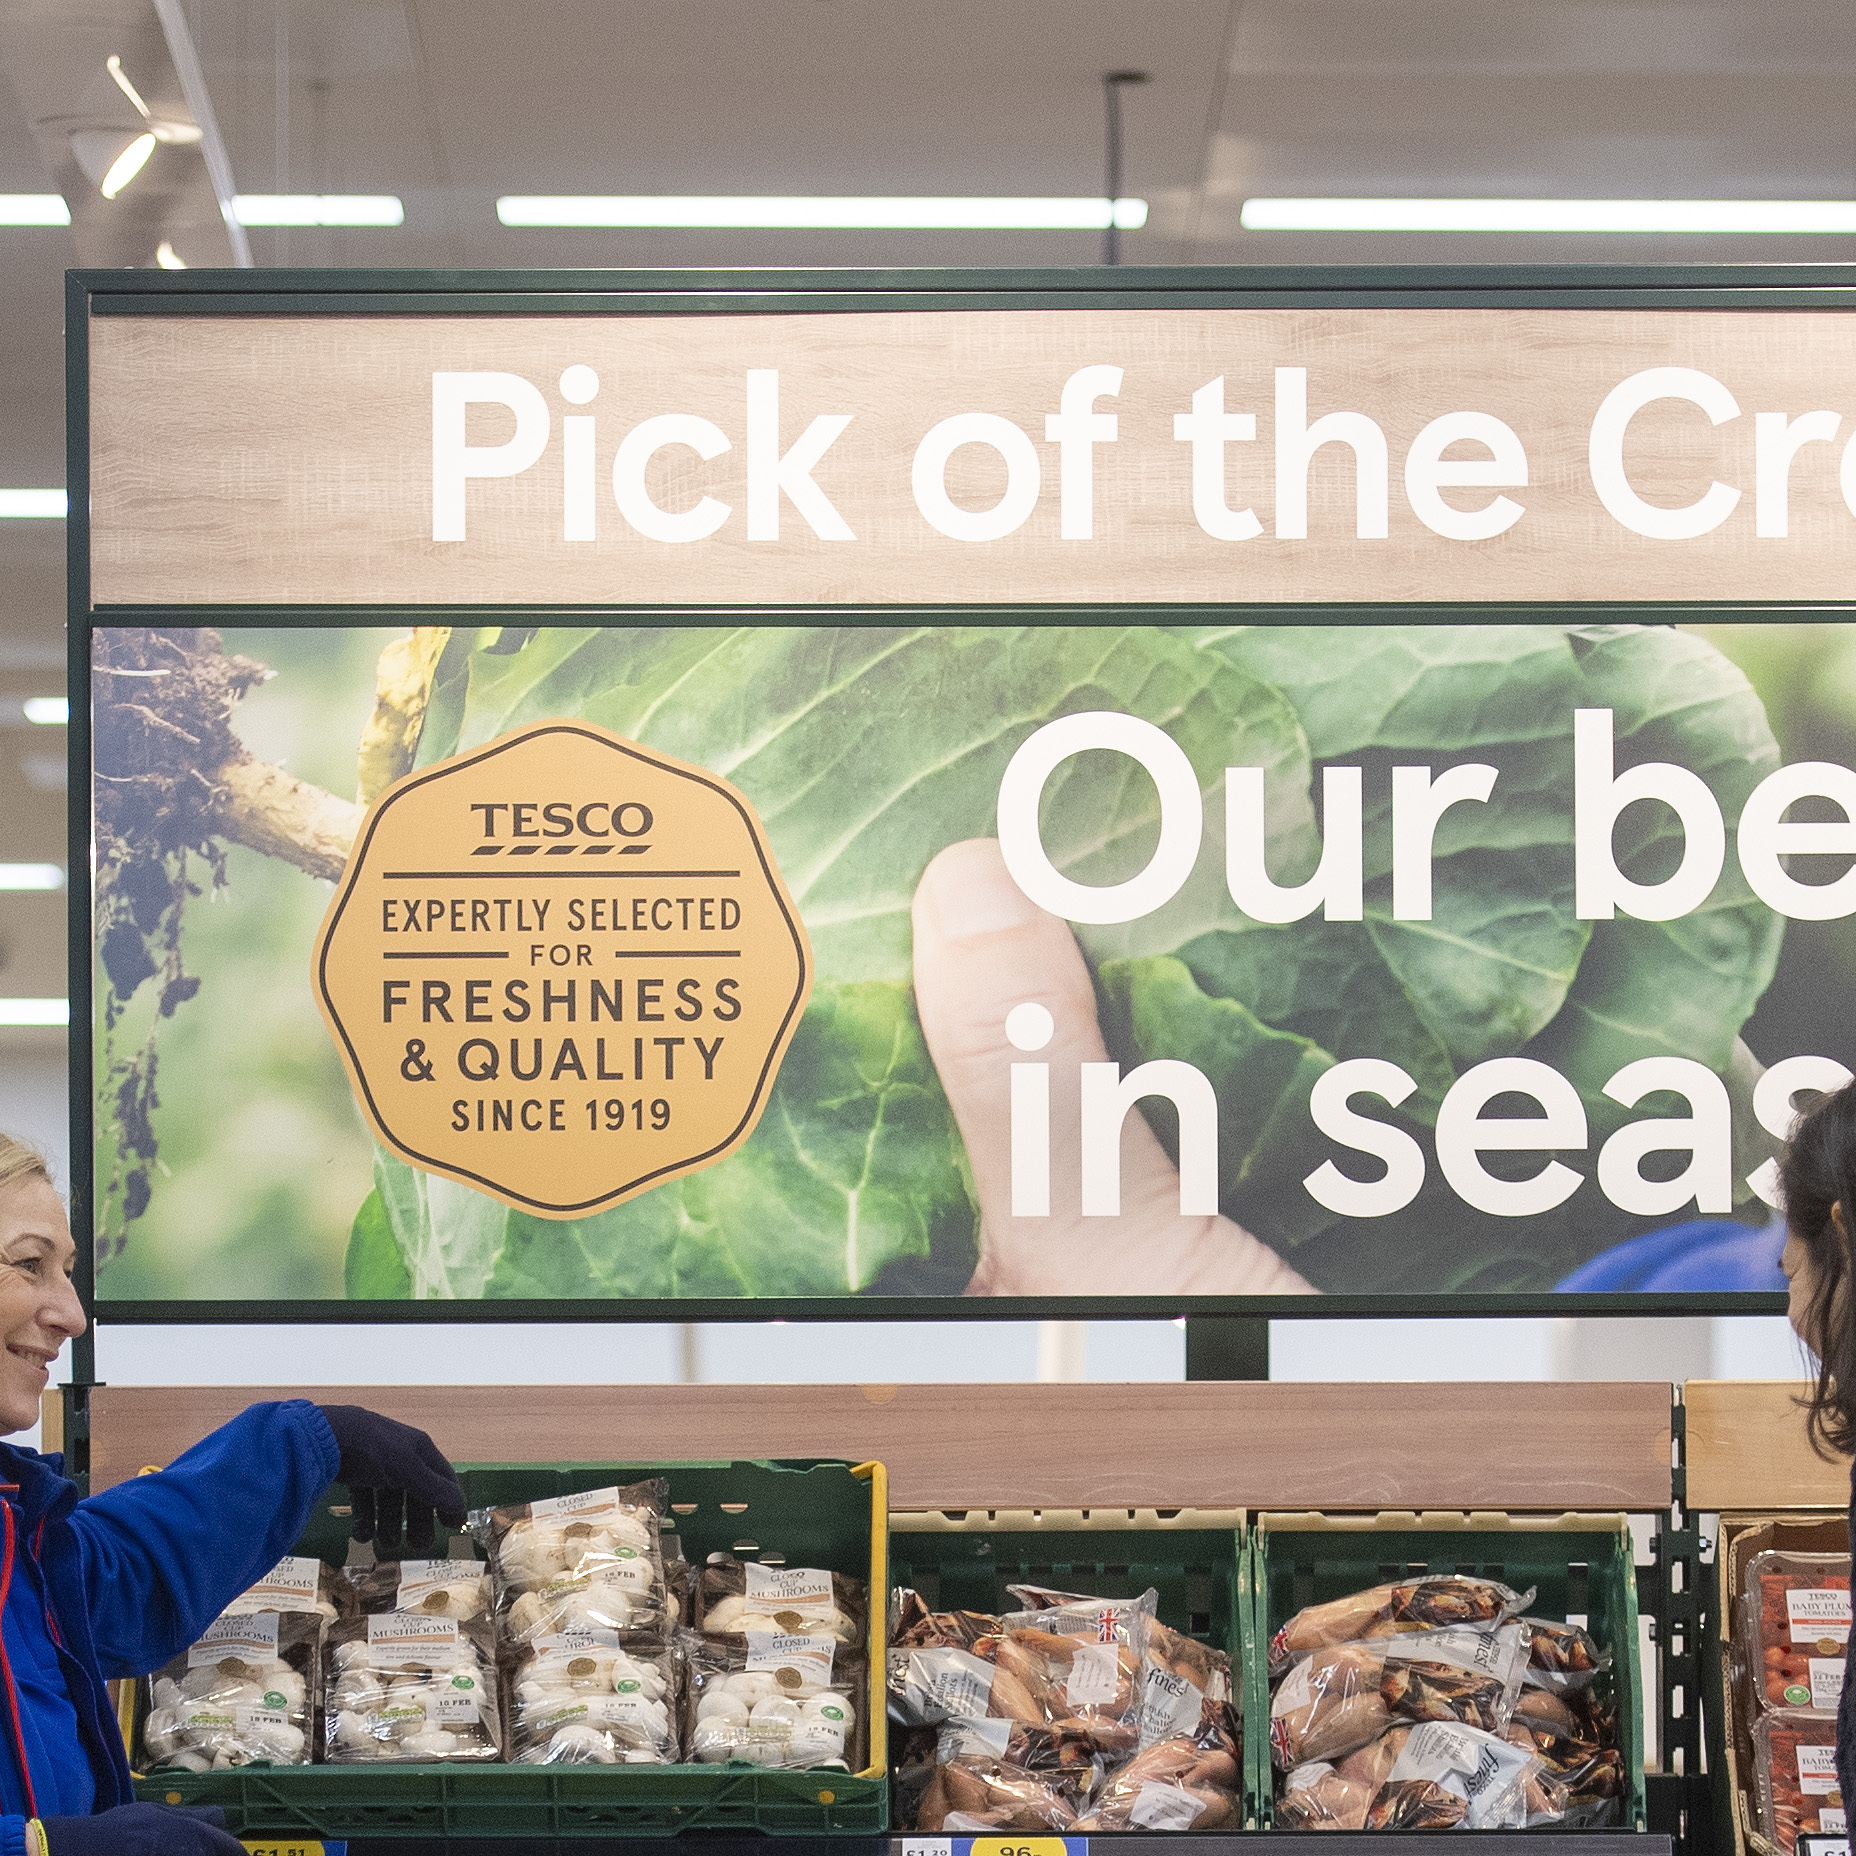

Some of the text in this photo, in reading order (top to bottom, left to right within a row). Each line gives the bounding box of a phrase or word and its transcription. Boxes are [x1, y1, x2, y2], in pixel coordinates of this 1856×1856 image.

[431, 363, 859, 544] Pick
[910, 364, 1125, 543] of
[1173, 365, 1530, 542] the
[470, 801, 654, 839] TESCO
[995, 710, 1501, 926] Our
[382, 897, 742, 933] EXPERTLY SELECTED
[530, 943, 594, 967] FOR
[382, 977, 744, 1024] FRESHNESS
[399, 1035, 726, 1082] & QUALITY
[450, 1097, 672, 1132] SINCE 1919
[1003, 1000, 1220, 1219] in
[1792, 1602, 1821, 1611] BABY
[1808, 1592, 1838, 1601] TESCO
[372, 1624, 454, 1639] MUSHROOMS
[772, 1637, 811, 1649] CLOSED
